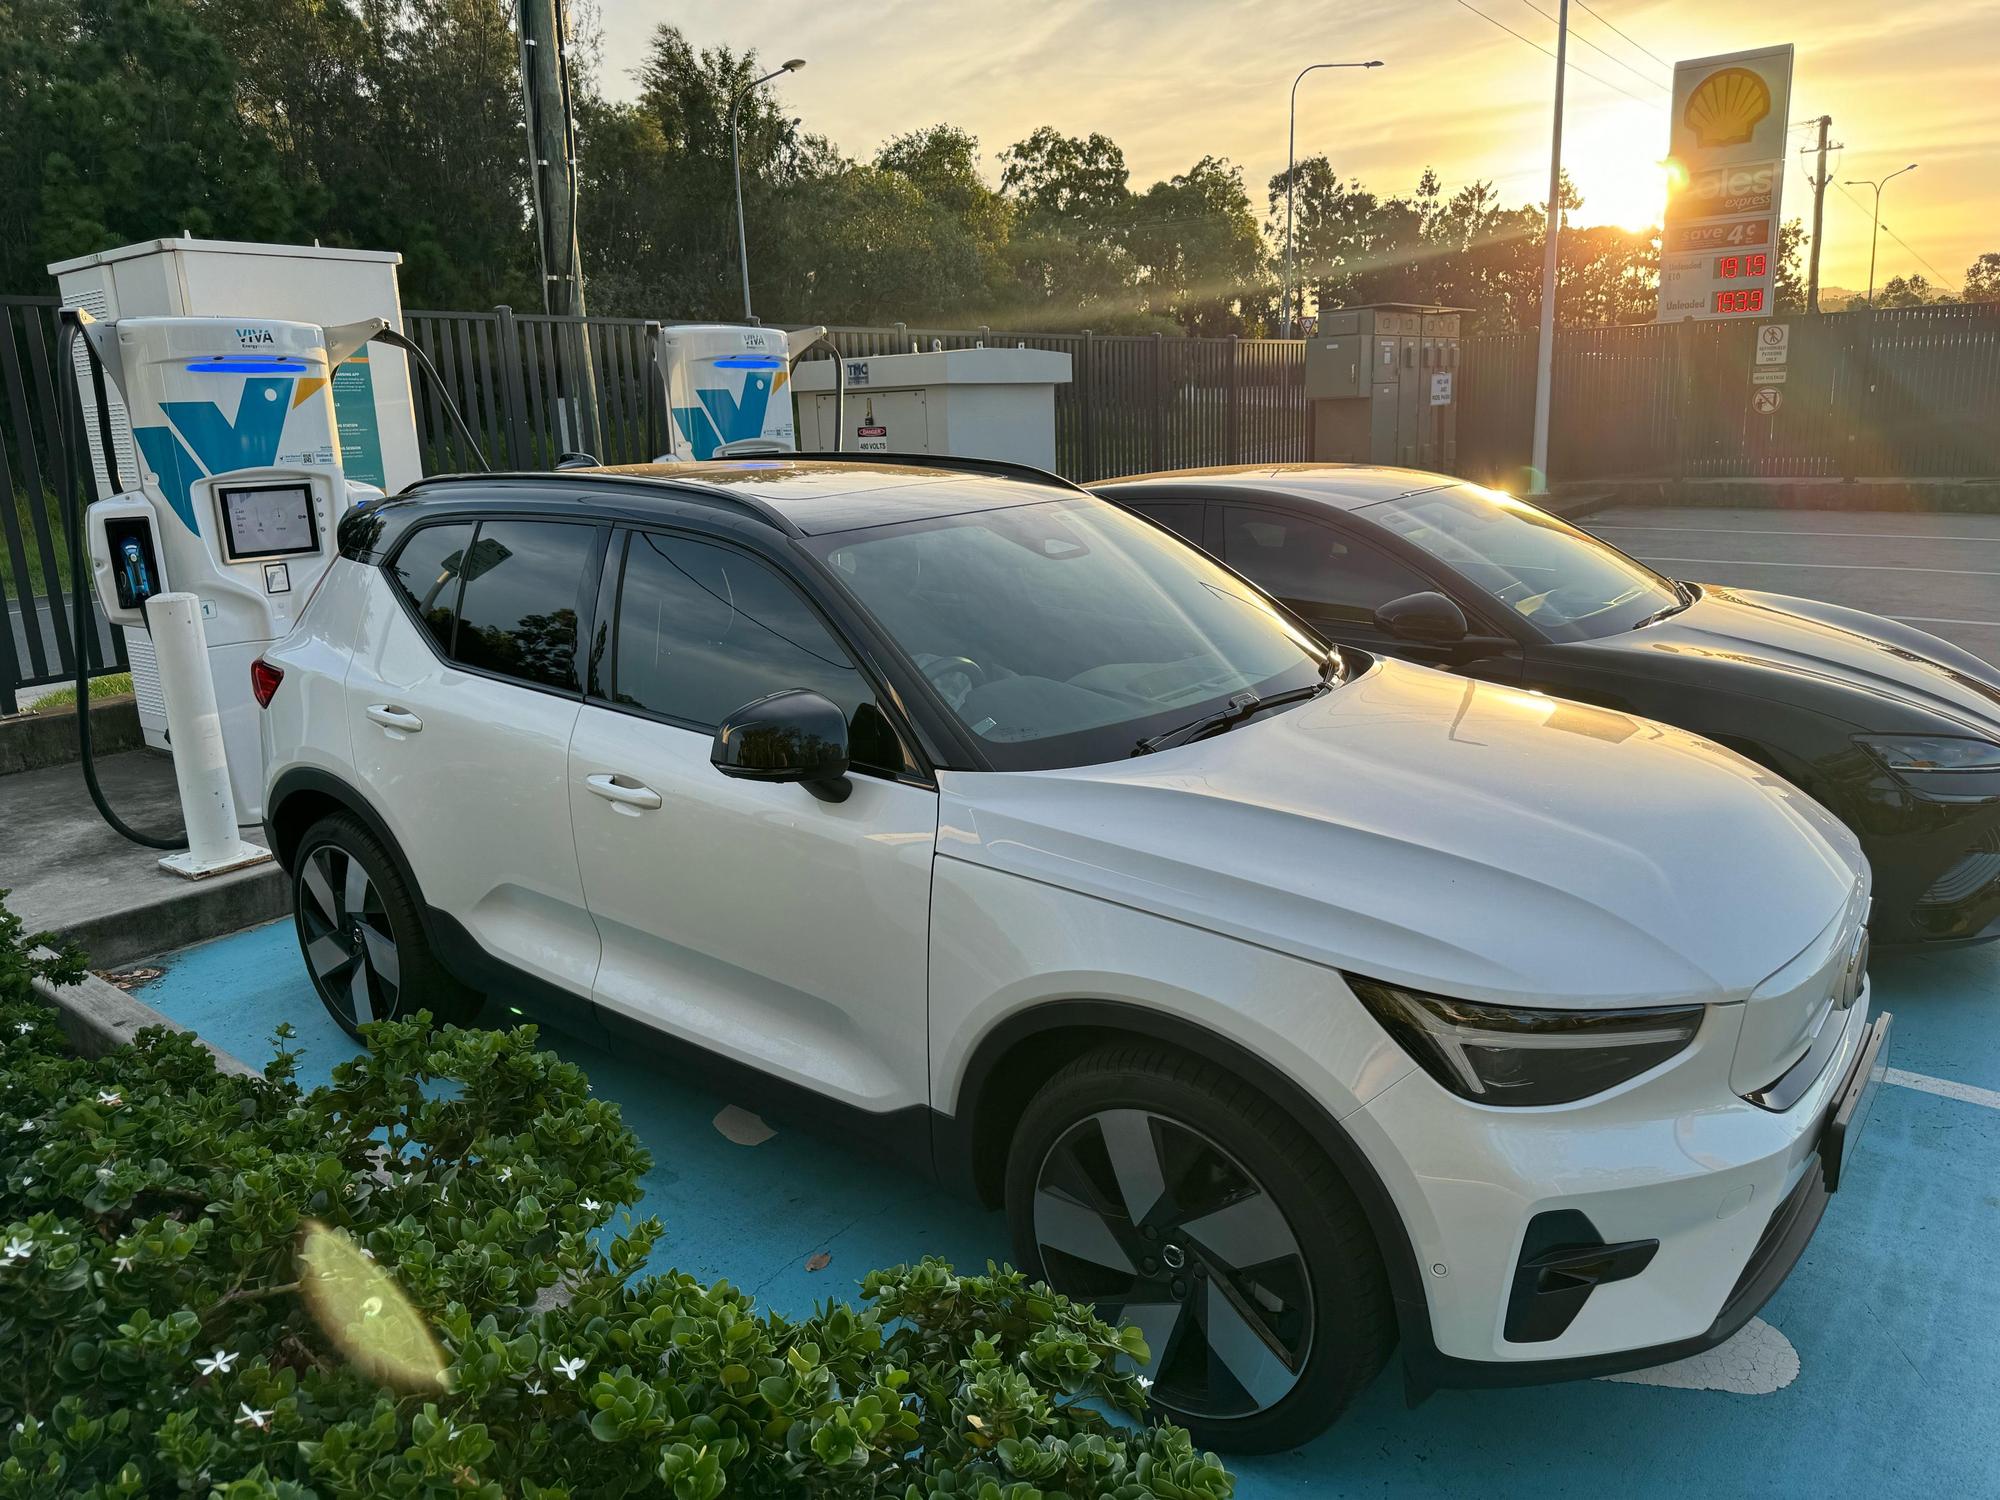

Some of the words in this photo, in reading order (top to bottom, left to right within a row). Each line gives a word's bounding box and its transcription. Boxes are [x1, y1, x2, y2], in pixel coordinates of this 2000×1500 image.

[1681, 227, 1723, 241] save
[1666, 299, 1705, 310] Unleaded
[235, 329, 274, 343] VIVA
[744, 335, 765, 345] VIVA
[847, 362, 869, 376] TMC
[203, 604, 209, 615] 1
